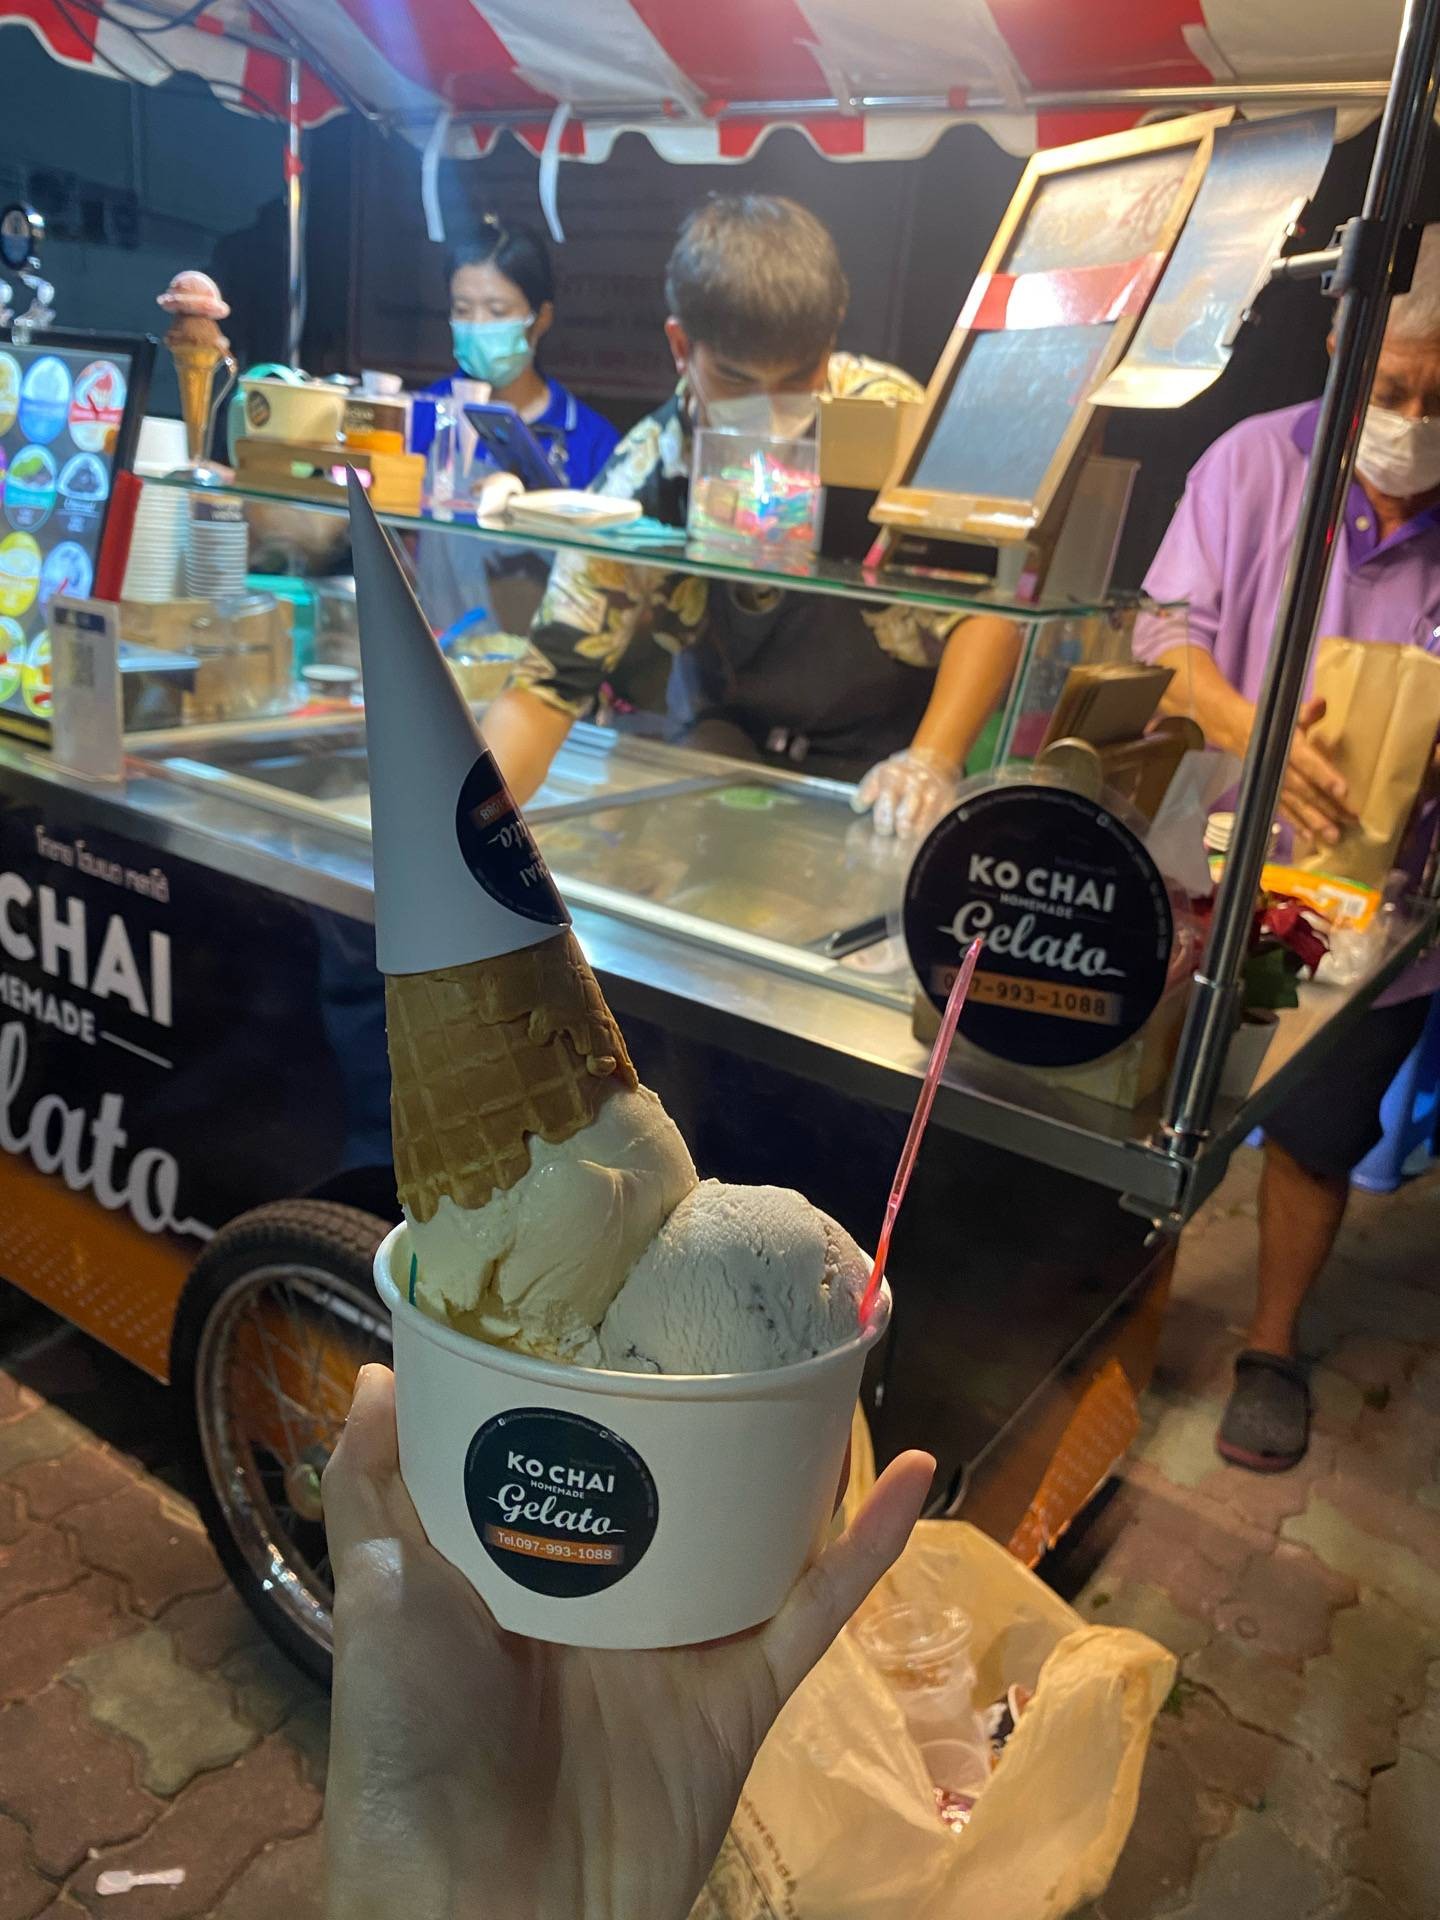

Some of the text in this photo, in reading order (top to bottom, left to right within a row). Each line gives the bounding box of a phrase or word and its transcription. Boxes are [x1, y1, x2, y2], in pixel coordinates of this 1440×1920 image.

[967, 853, 1021, 891] KO
[1025, 867, 1117, 913] CHAI
[999, 891, 1075, 921] HOMEMADE
[0, 871, 173, 1028] CHAI
[936, 899, 1128, 978] Gelato
[943, 971, 1108, 1018] 07-993-1088
[506, 1450, 544, 1478] KO
[549, 1465, 615, 1494] CHAI
[530, 1479, 585, 1500] HOMEMADE
[487, 1482, 626, 1536] Gelato
